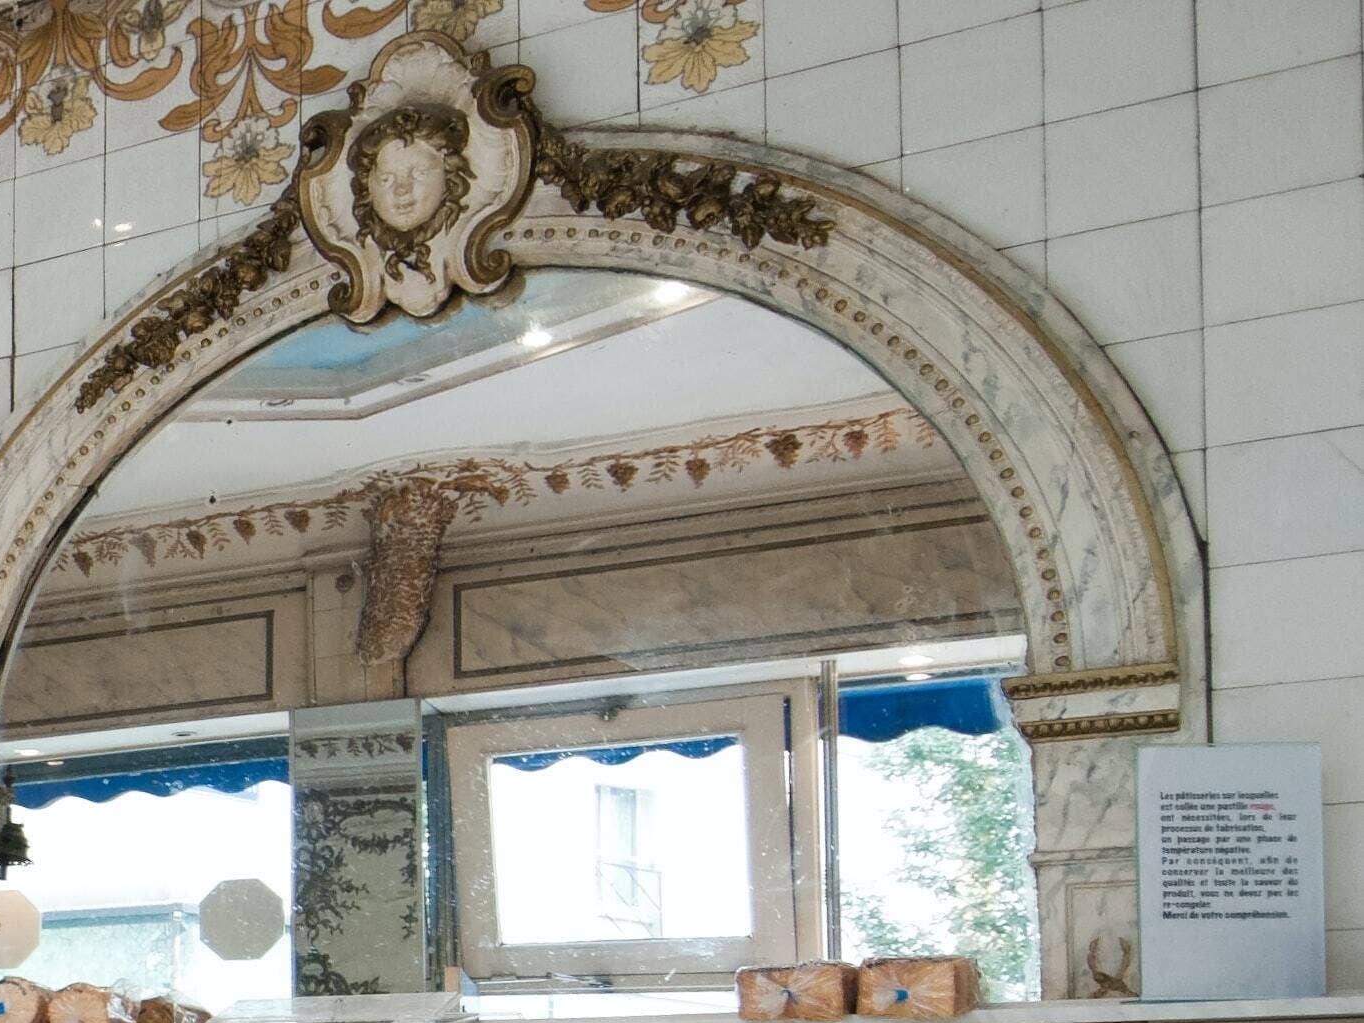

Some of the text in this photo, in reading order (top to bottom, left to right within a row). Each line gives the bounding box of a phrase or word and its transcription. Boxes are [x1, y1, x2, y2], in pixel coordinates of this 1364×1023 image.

[1160, 791, 1173, 800] Les
[1162, 856, 1179, 865] Par
[1162, 868, 1209, 876] conserver
[1163, 911, 1188, 919] Merci
[1201, 911, 1224, 919] votre
